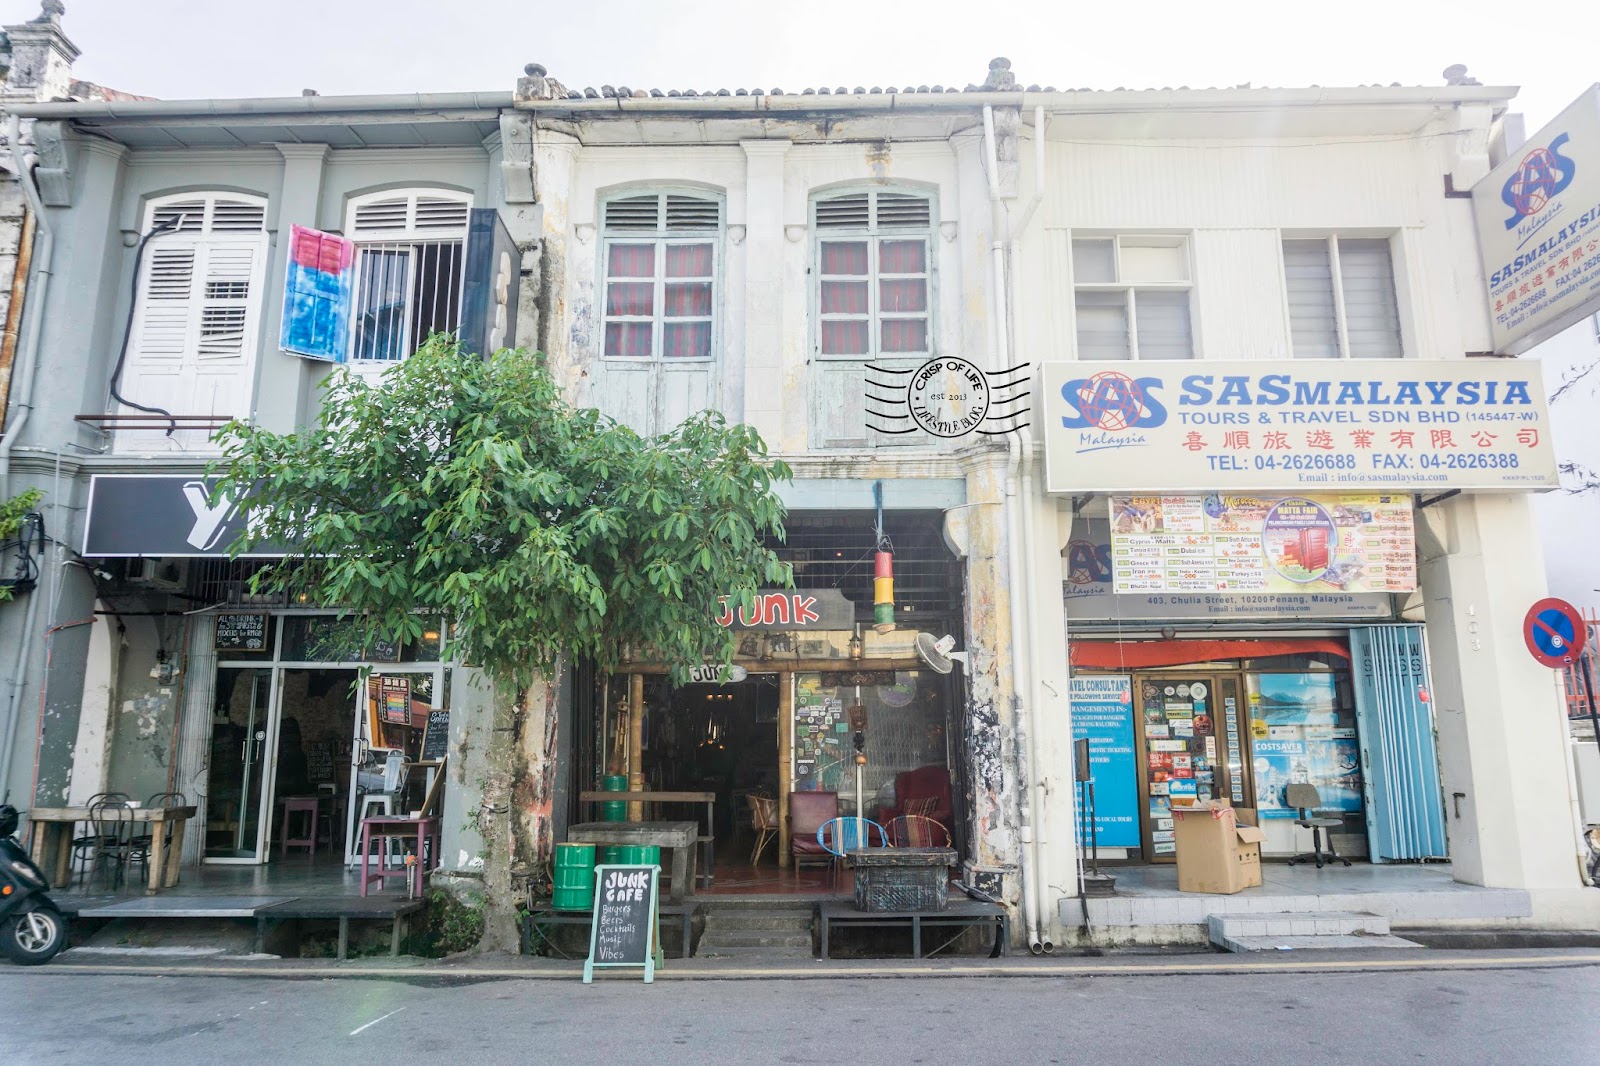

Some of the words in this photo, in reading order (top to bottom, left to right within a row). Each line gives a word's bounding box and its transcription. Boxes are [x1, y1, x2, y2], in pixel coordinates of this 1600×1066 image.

[1502, 132, 1576, 231] SAS
[1518, 201, 1563, 239] Malaysia
[1491, 280, 1513, 298] TOURS
[1514, 276, 1520, 284] &
[1520, 258, 1547, 279] TRAVEL
[1548, 247, 1564, 261] SDN
[1565, 233, 1582, 250] BHD
[1506, 312, 1525, 330] Email
[1061, 376, 1168, 429] SAS
[1178, 411, 1251, 425] TOURS
[1258, 411, 1272, 424] &
[1278, 410, 1362, 424] TRAVEL
[1368, 410, 1411, 423] SDN
[1417, 410, 1461, 423] BHD
[1466, 411, 1539, 422] (145447-W)
[1080, 432, 1147, 449] Malaysia
[1206, 454, 1250, 471] TEL:
[1254, 453, 1357, 470] 04-2626688
[1372, 453, 1415, 470] FAX:
[1419, 452, 1520, 469] 04-2626388
[1299, 472, 1328, 482] Email
[1337, 472, 1449, 484] info@sasmalaysia.com
[1132, 497, 1162, 505] EGYPT
[1277, 506, 1301, 515] MATTA
[1302, 506, 1319, 515] FAIR
[1333, 546, 1366, 554] Emirates
[1147, 596, 1167, 606] 403,
[1171, 596, 1202, 604] Chulia
[1205, 596, 1237, 604] Street,
[1242, 595, 1268, 604] 10200
[1269, 595, 1308, 605] Penang,
[1311, 595, 1354, 605] Malaysia
[1208, 605, 1229, 613] Email
[1255, 742, 1302, 751] COSTSAVER
[605, 871, 649, 889] JUNK
[602, 904, 632, 916] Burgers
[599, 923, 636, 934] Cocktails
[599, 946, 625, 960] Vibes
